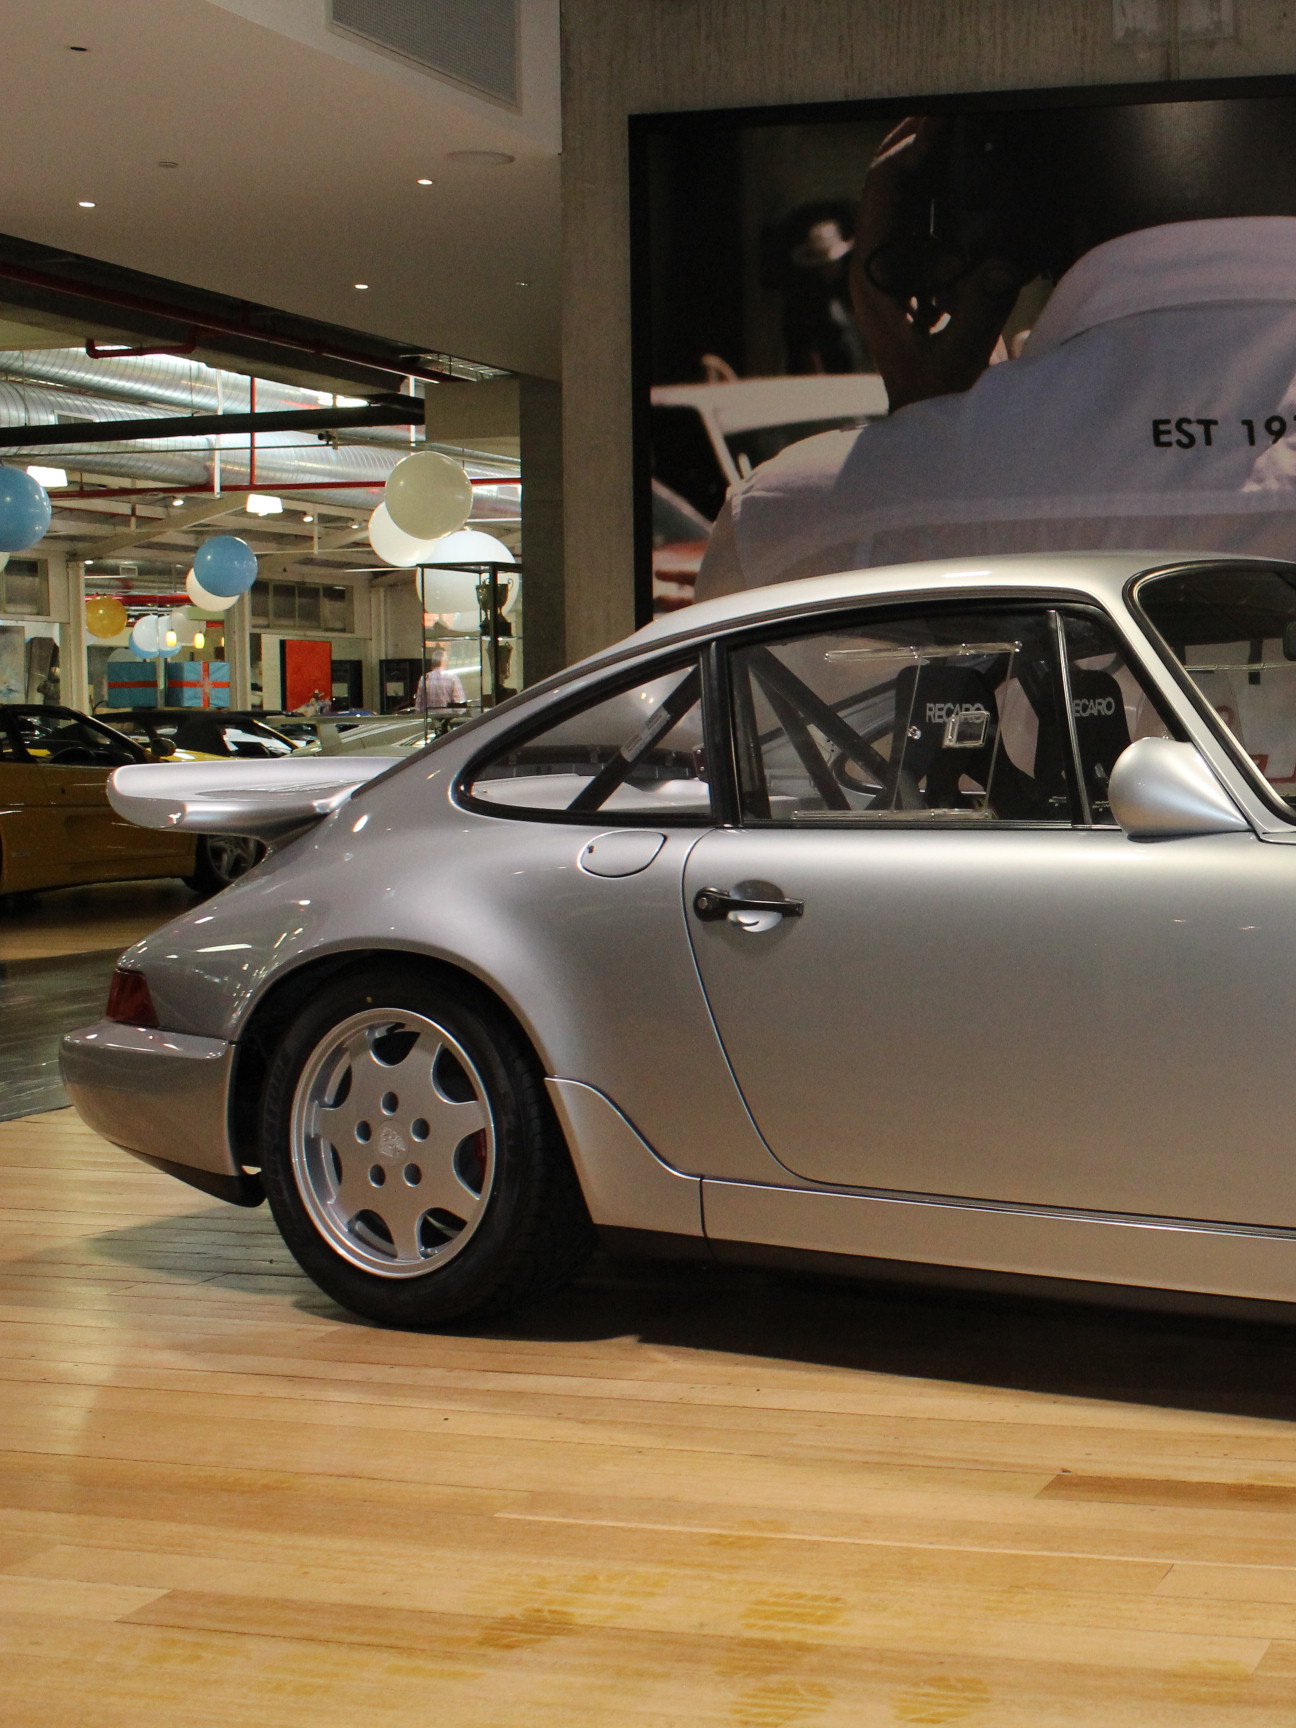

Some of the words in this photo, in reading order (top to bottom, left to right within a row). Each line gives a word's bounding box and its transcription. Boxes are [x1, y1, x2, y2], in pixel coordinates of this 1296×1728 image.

[1152, 416, 1219, 449] EST
[926, 702, 986, 723] RECARO
[1071, 697, 1116, 717] ECARO
